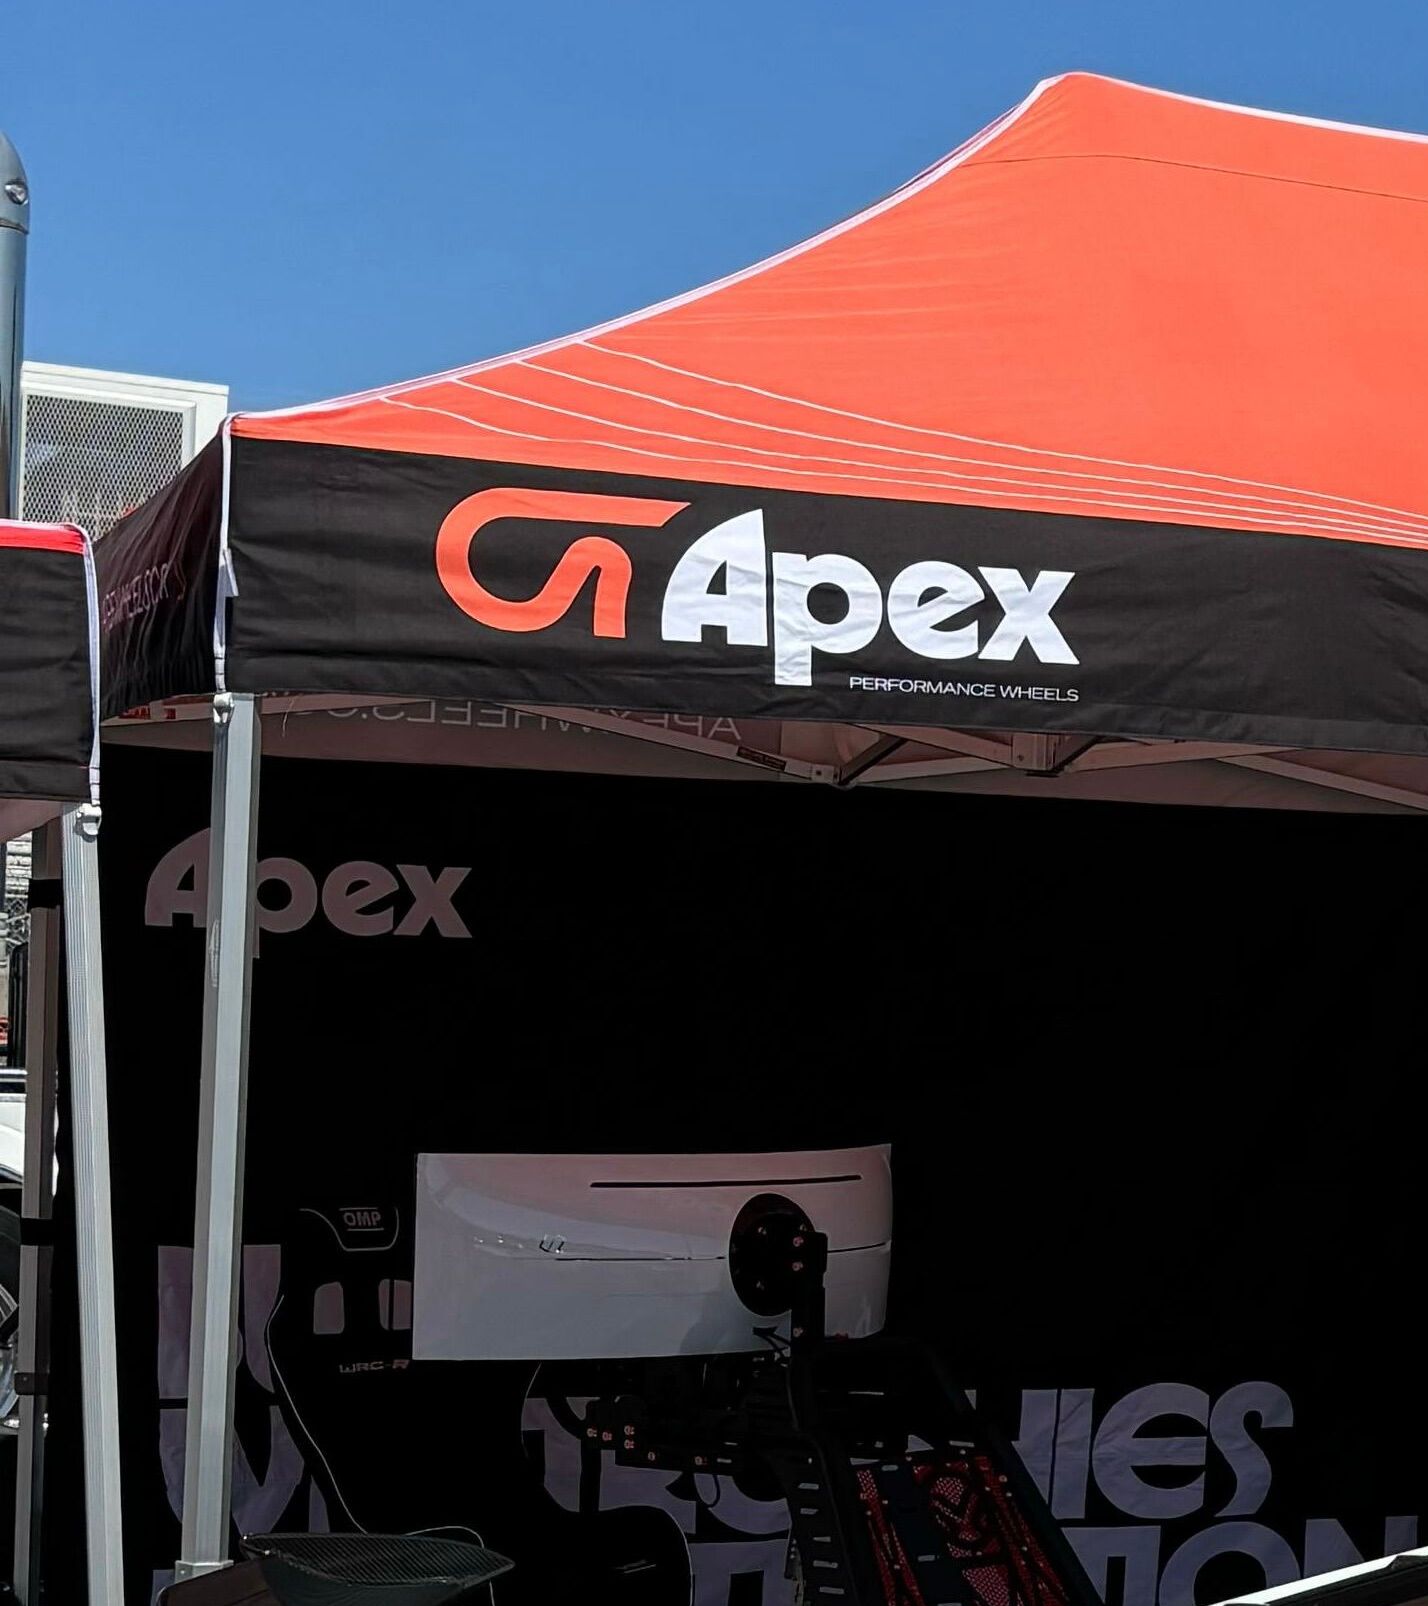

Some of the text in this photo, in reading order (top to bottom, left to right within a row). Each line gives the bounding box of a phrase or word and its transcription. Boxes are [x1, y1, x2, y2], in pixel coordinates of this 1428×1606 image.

[660, 508, 1081, 686] Apex
[849, 675, 1080, 702] PERFORMANCE WHEELS
[343, 1210, 382, 1228] OMP
